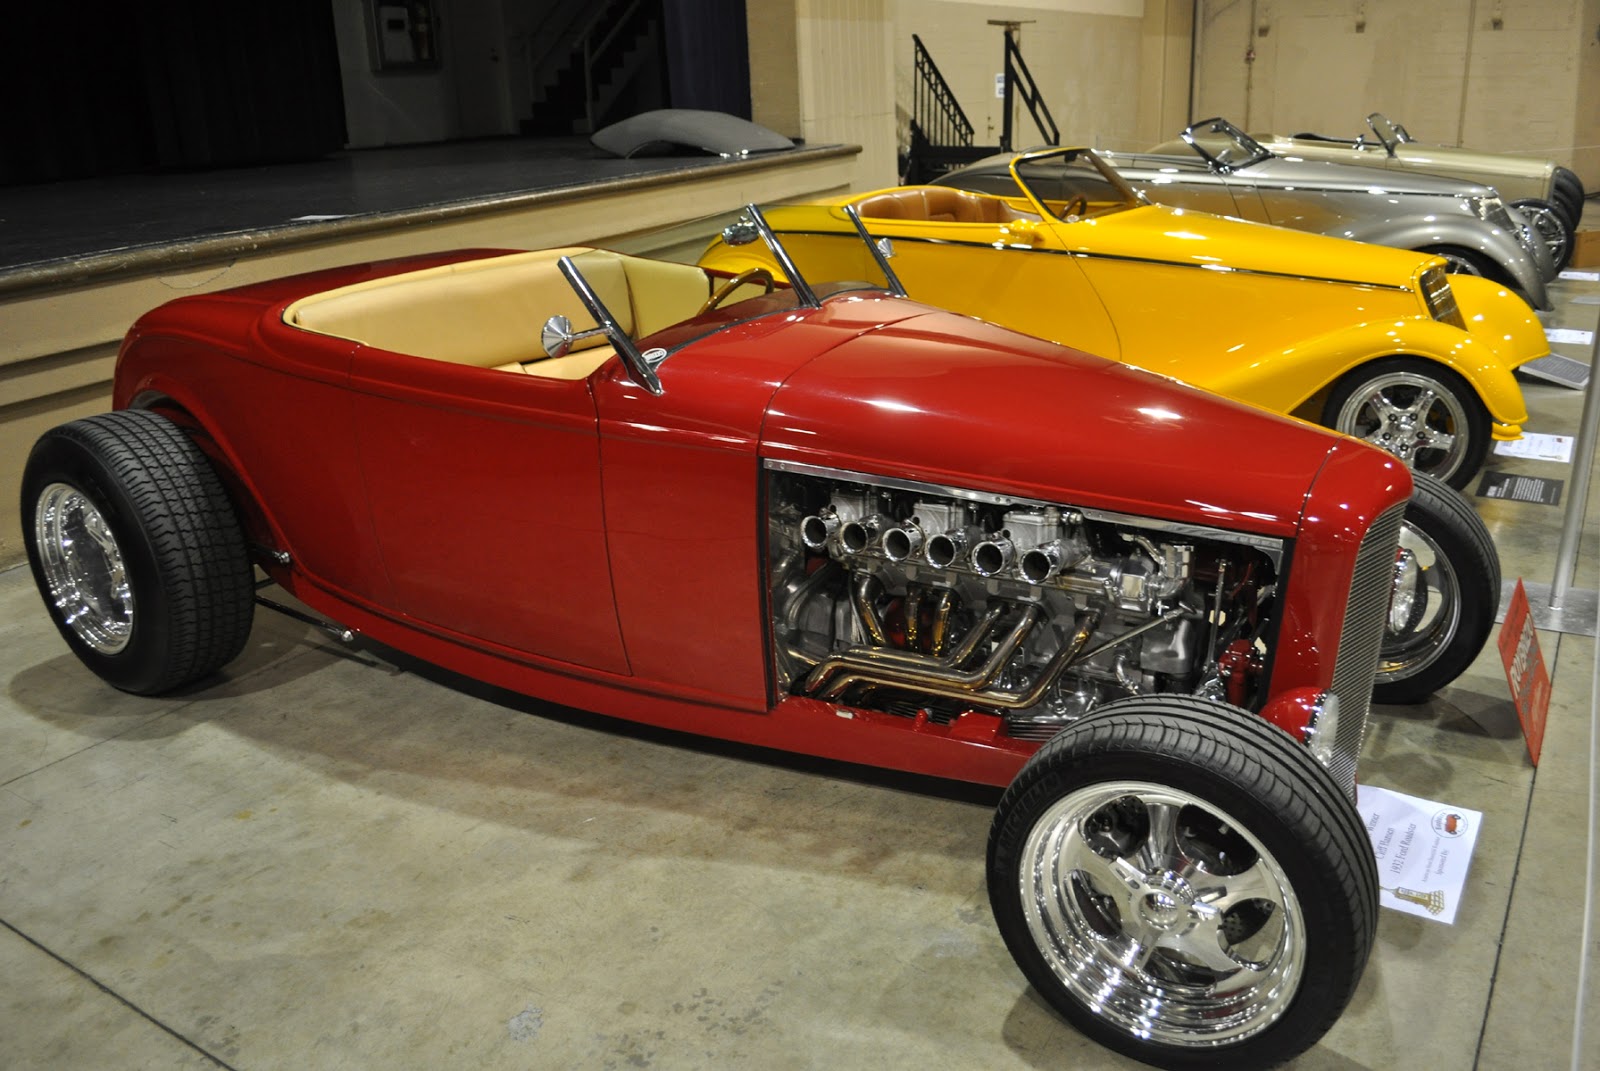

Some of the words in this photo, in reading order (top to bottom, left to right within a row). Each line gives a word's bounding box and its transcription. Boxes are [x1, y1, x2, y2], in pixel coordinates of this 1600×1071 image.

[1400, 823, 1416, 845] Roadster
[1395, 844, 1408, 859] Ford
[1390, 858, 1403, 873] 1932
